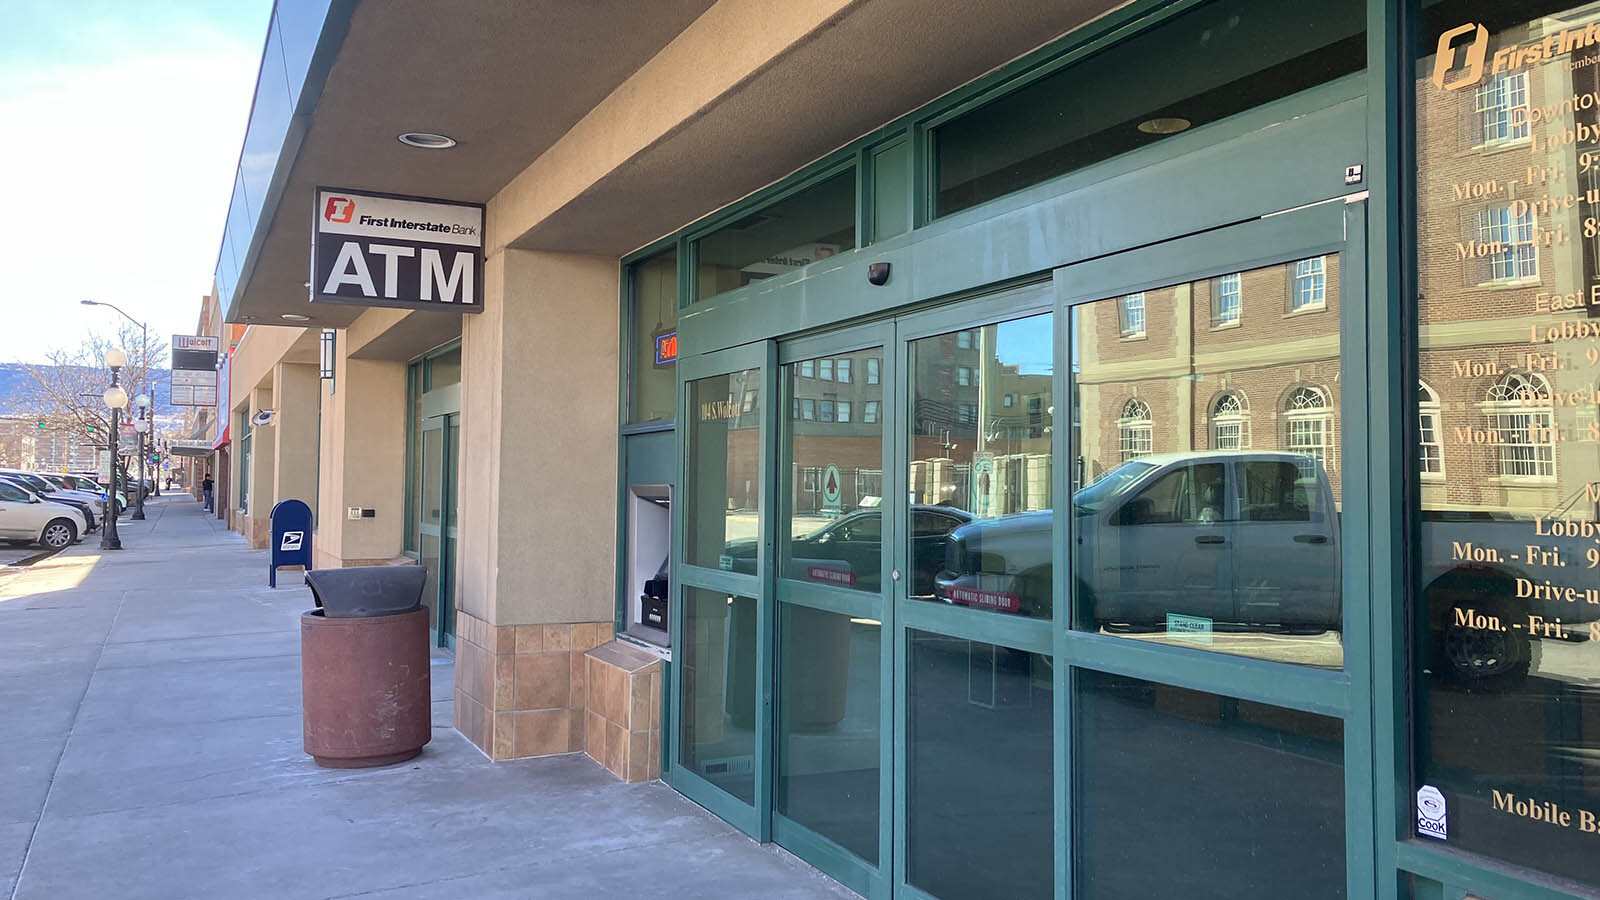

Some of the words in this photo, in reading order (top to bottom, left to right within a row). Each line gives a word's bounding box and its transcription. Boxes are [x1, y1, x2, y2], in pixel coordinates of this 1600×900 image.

[1492, 37, 1553, 75] First
[1452, 179, 1504, 200] Mon.
[1527, 160, 1565, 185] Fri.
[359, 215, 389, 228] First
[390, 217, 451, 233] Interstate
[452, 224, 477, 236] Bank
[1456, 239, 1508, 261] Mon.
[322, 241, 475, 304] ATM
[1535, 289, 1585, 312] East
[1452, 360, 1504, 379] Mon.
[1526, 351, 1564, 372] Fri.
[1454, 426, 1505, 445] Mon.
[1452, 541, 1505, 563] Mon.
[1525, 545, 1566, 567] Fri.
[1454, 607, 1507, 632] Mon.
[1528, 615, 1569, 639] Fri.
[1492, 789, 1571, 828] Mobile
[1578, 809, 1600, 835] B
